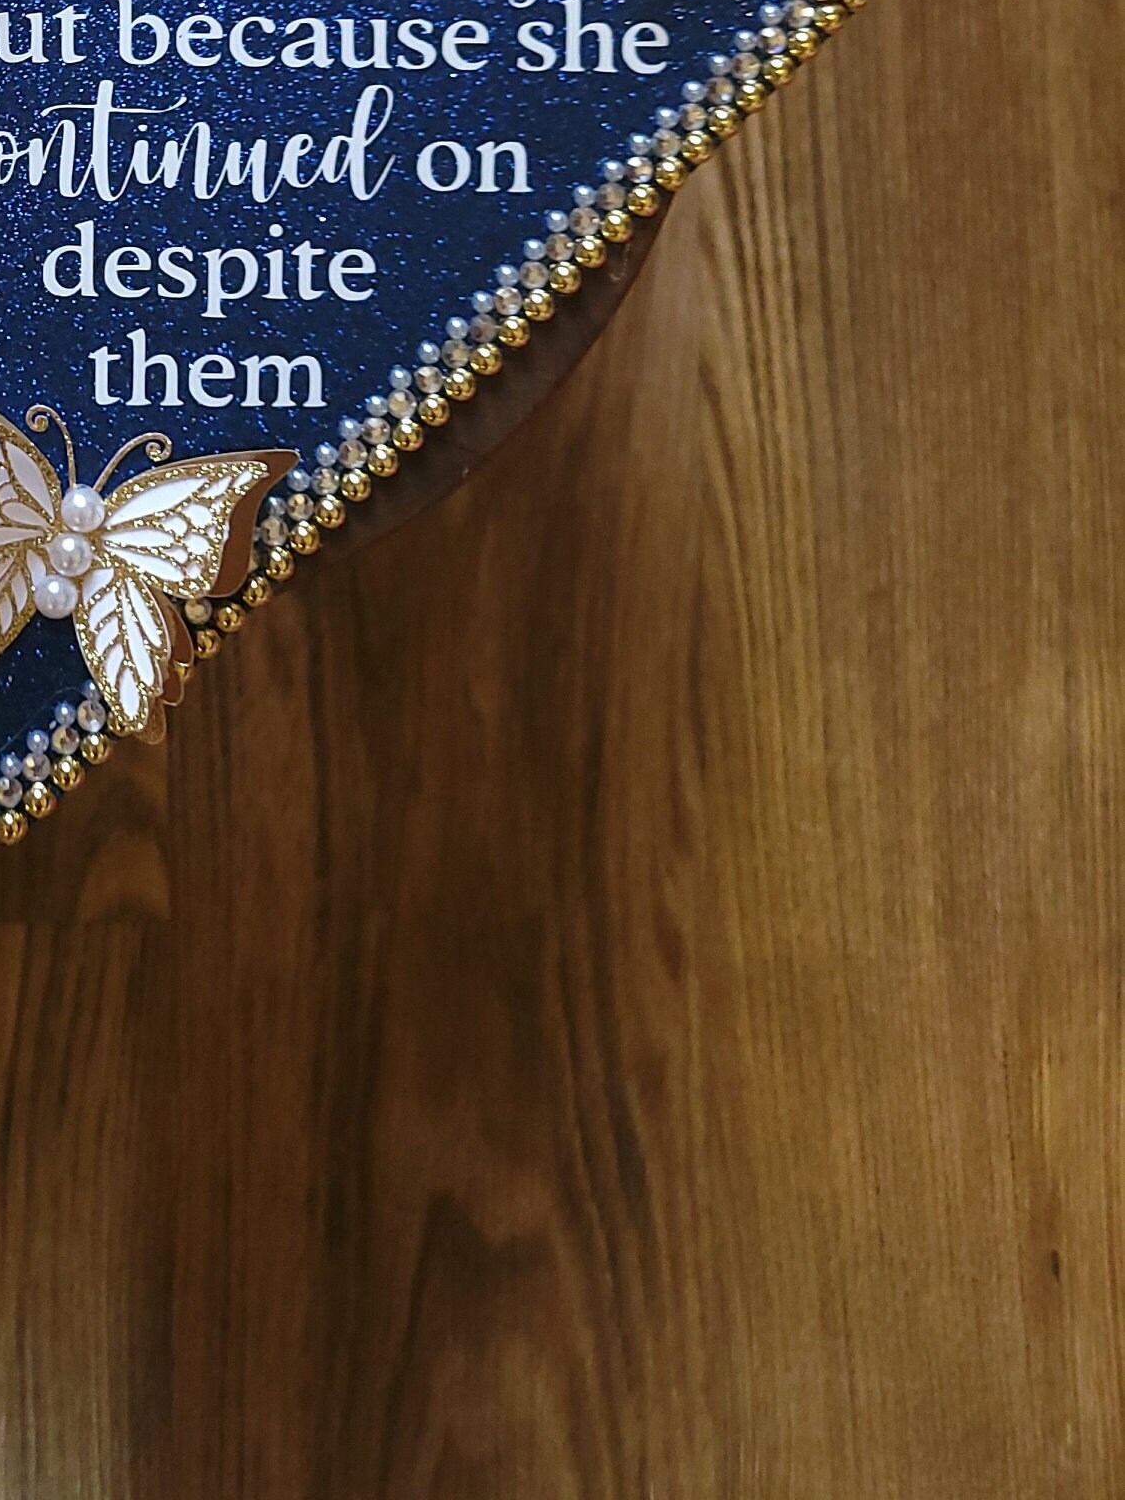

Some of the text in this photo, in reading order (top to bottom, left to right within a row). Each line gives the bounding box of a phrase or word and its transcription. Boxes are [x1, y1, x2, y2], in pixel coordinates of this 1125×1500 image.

[416, 141, 532, 192] on
[41, 220, 376, 318] despite
[87, 328, 327, 407] them
